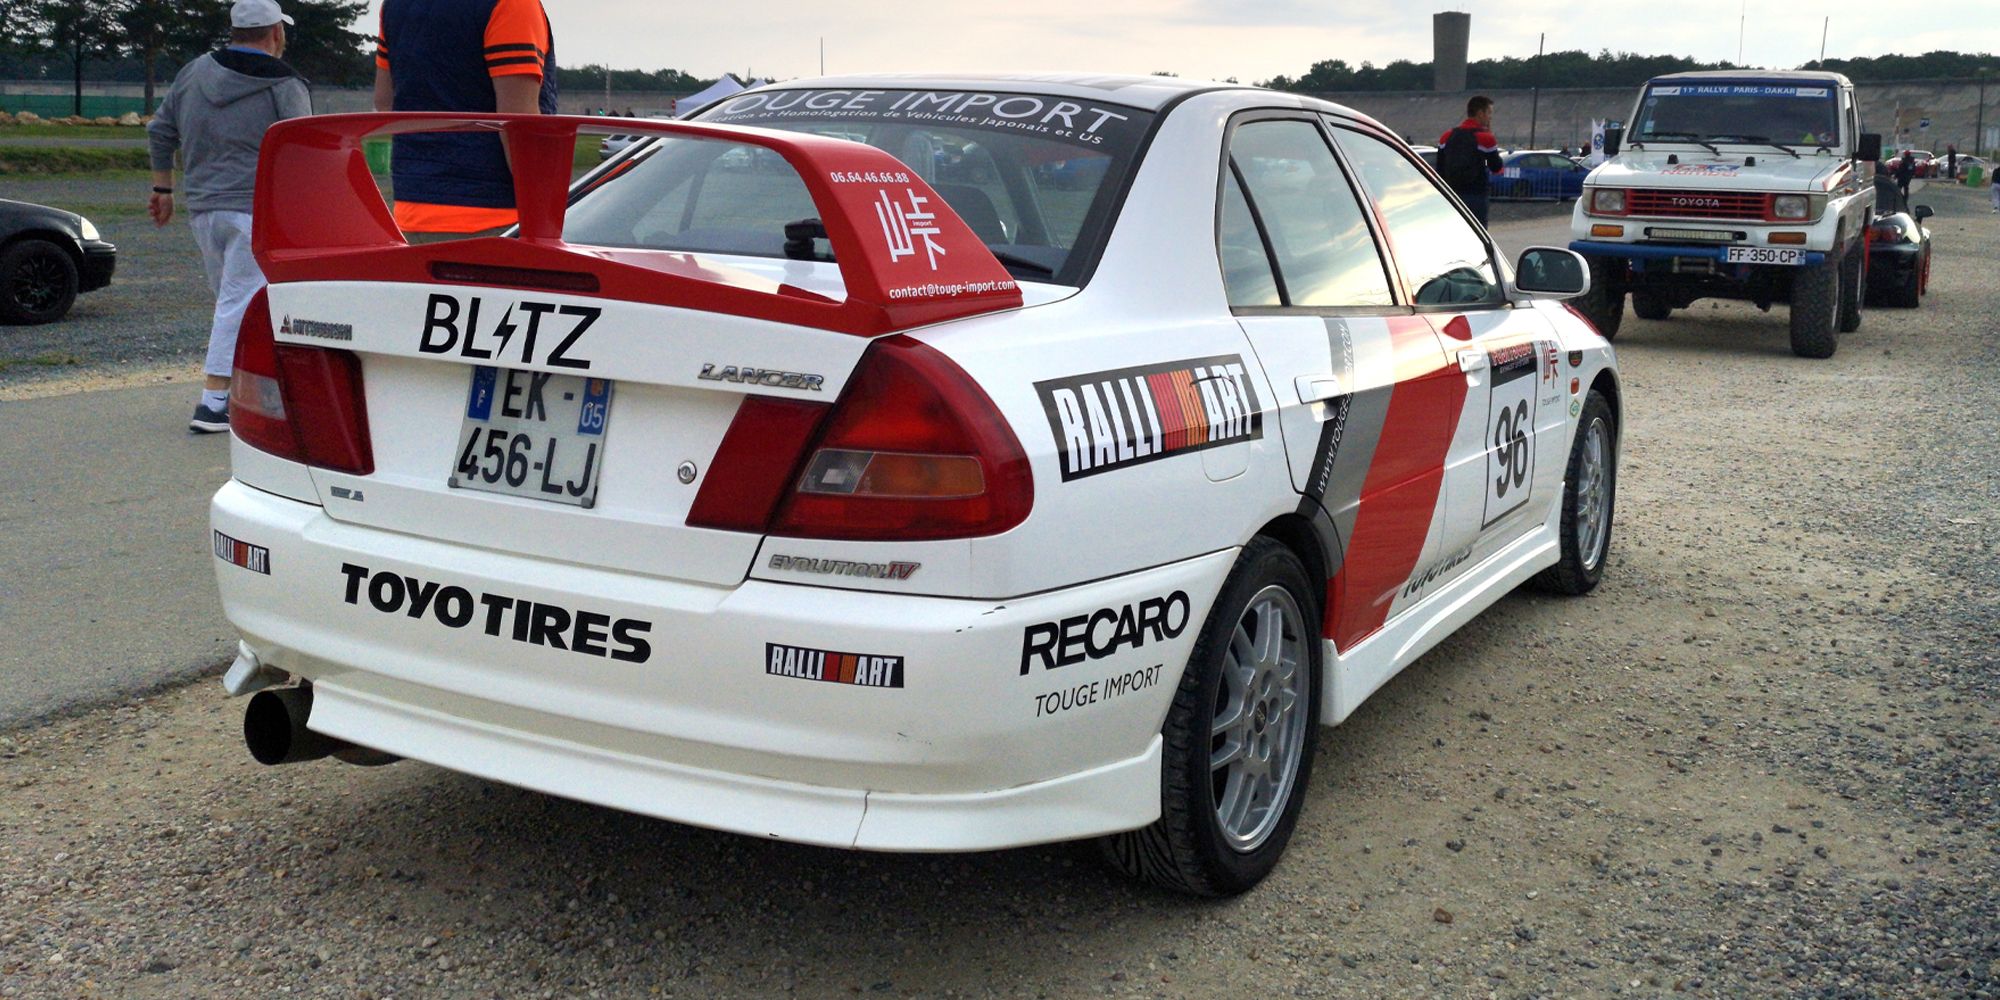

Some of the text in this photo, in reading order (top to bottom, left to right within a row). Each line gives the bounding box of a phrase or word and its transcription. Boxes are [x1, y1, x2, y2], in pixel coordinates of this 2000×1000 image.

[723, 90, 1128, 134] OUGE IMPORT
[759, 110, 772, 118] et
[775, 109, 877, 118] Homologation
[906, 111, 976, 123] Véhicules
[979, 117, 1049, 133] Japonais
[1055, 129, 1072, 138] et
[1079, 132, 1104, 145] US
[830, 171, 910, 183] 06.64.46.66.88
[1672, 198, 1720, 207] TOYOTA
[889, 280, 1016, 299] contact@touge-import.com
[698, 363, 824, 391] LANCER
[581, 402, 604, 428] 05
[1495, 398, 1528, 499] 96
[341, 562, 652, 664] TOYO TIRES
[1019, 590, 1190, 676] RECARO
[1035, 664, 1163, 717] TOUGE IMPORT
